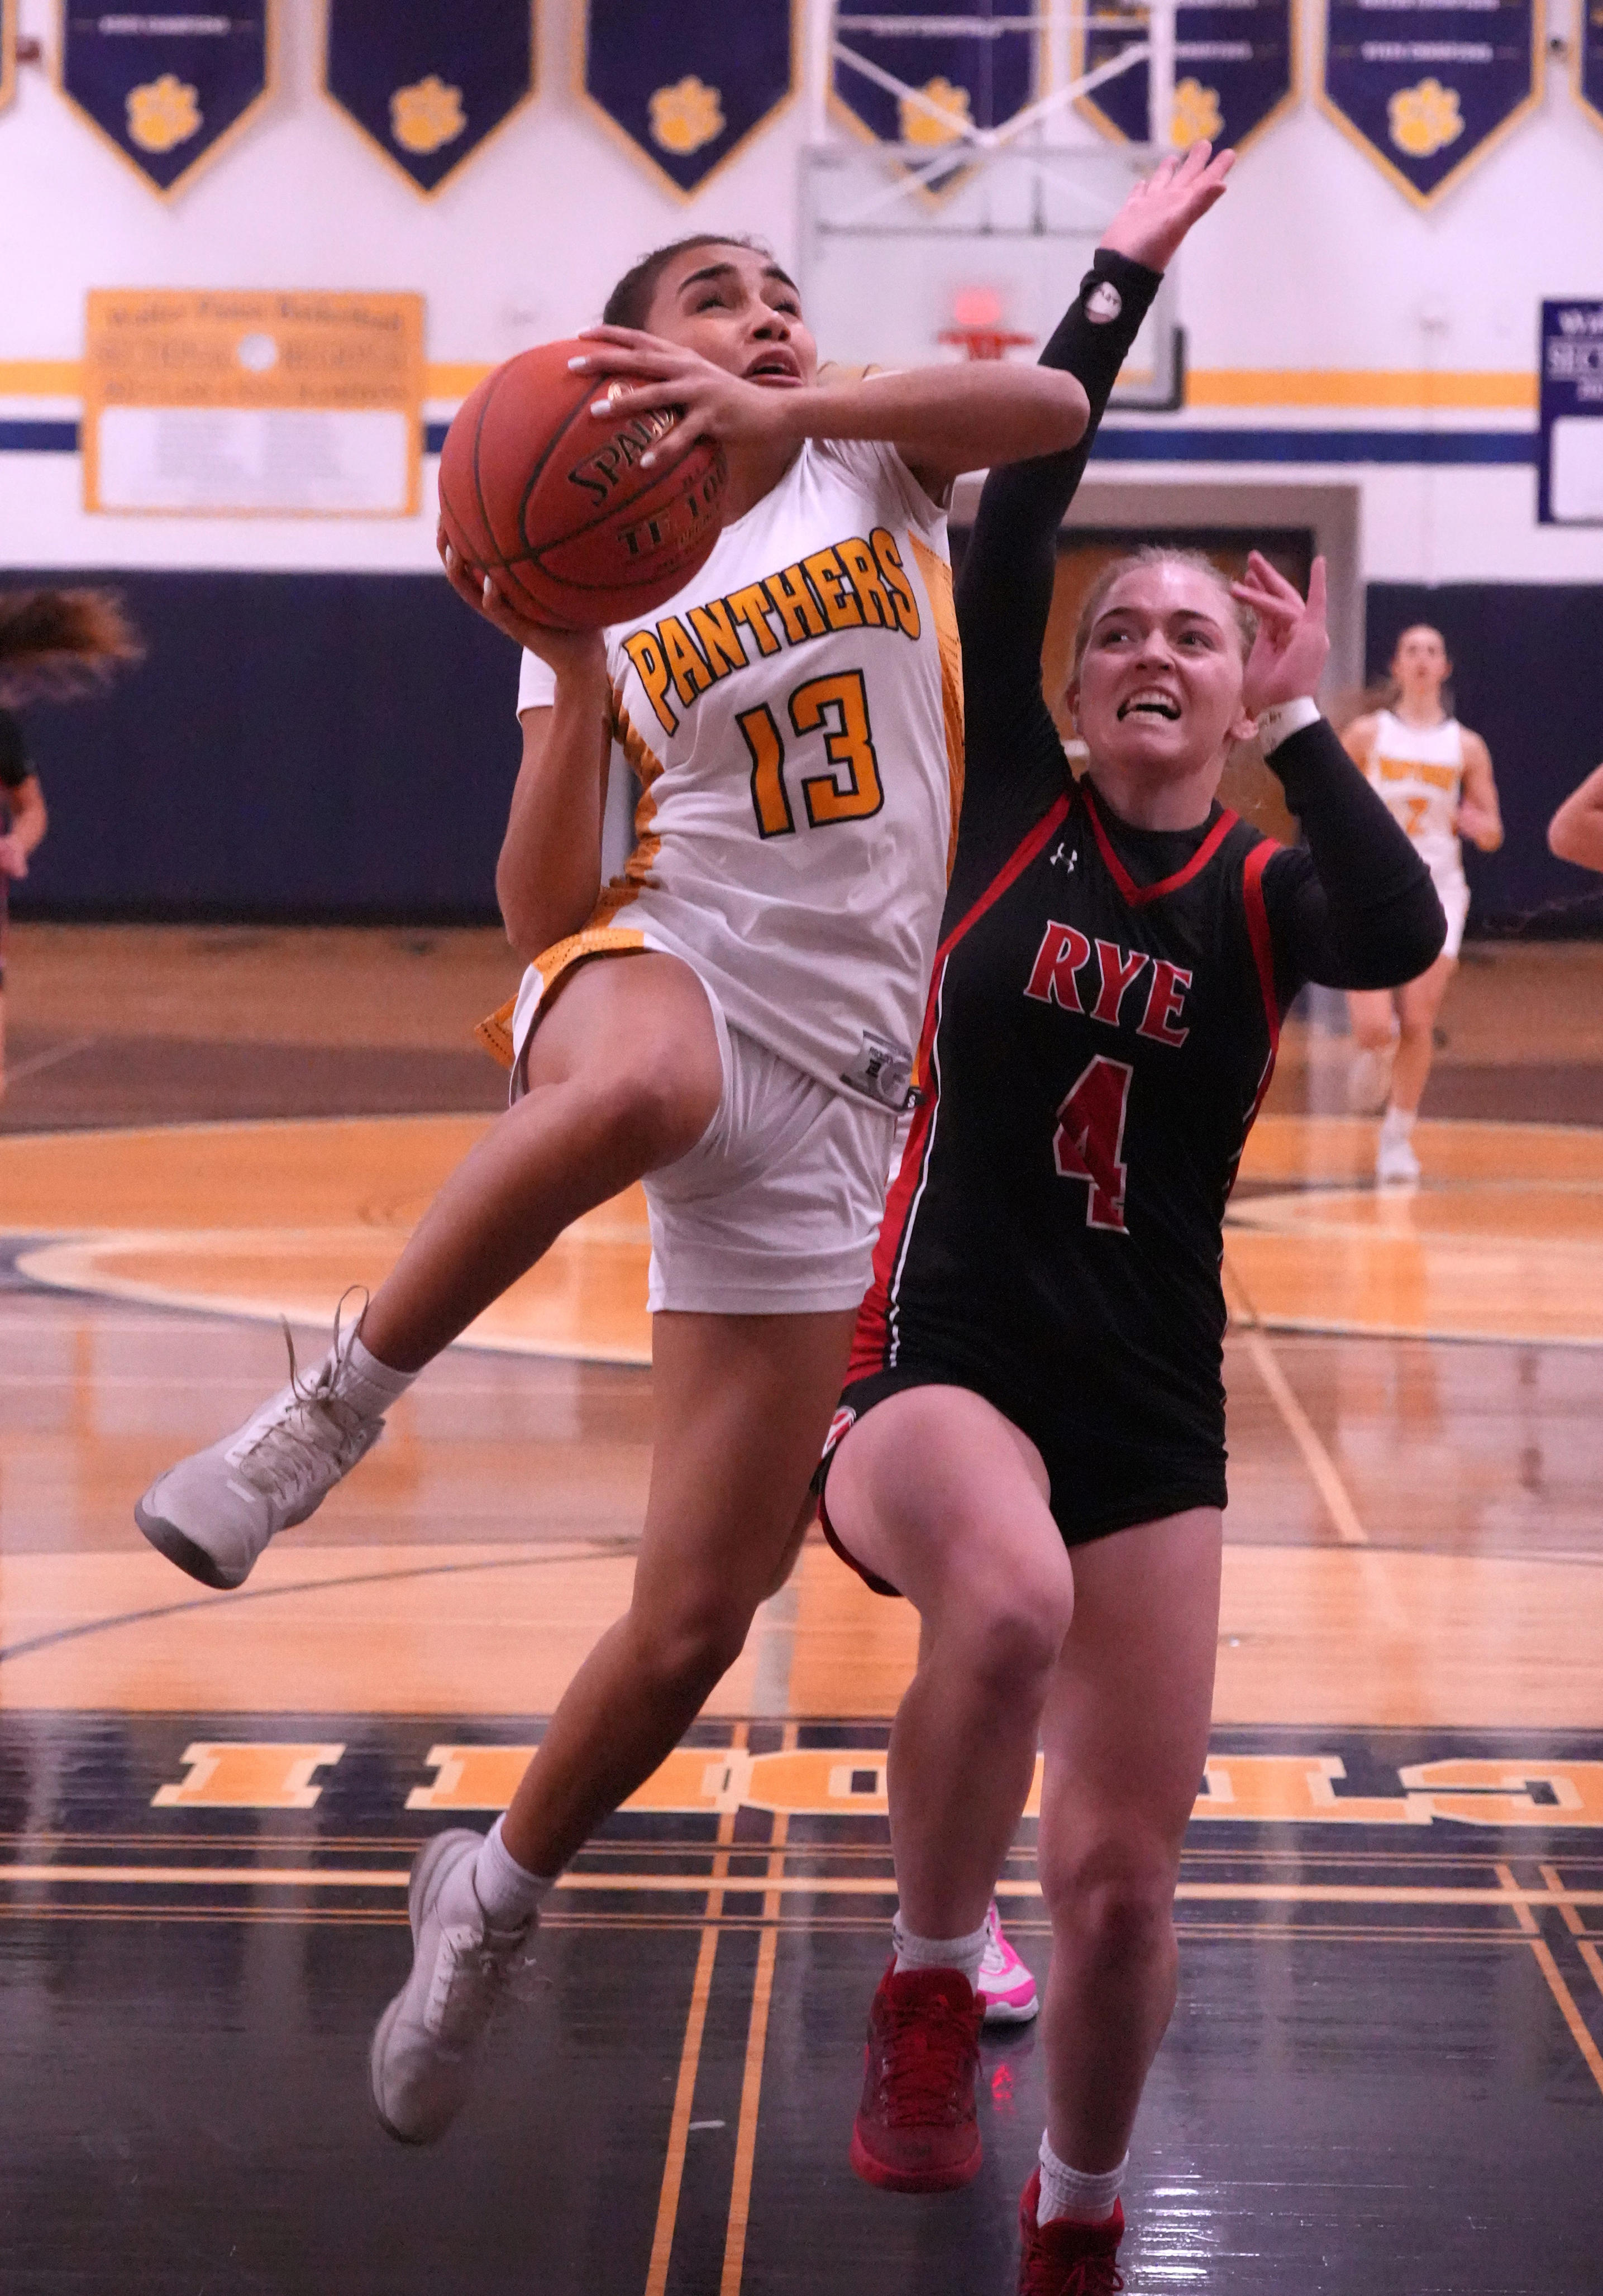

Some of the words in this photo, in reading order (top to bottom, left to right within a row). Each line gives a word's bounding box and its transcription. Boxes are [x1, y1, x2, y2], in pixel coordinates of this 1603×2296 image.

[622, 527, 920, 737] PANTHERS
[734, 669, 885, 839] 13
[1023, 919, 1193, 1048] RYE
[1053, 1054, 1134, 1235] 4
